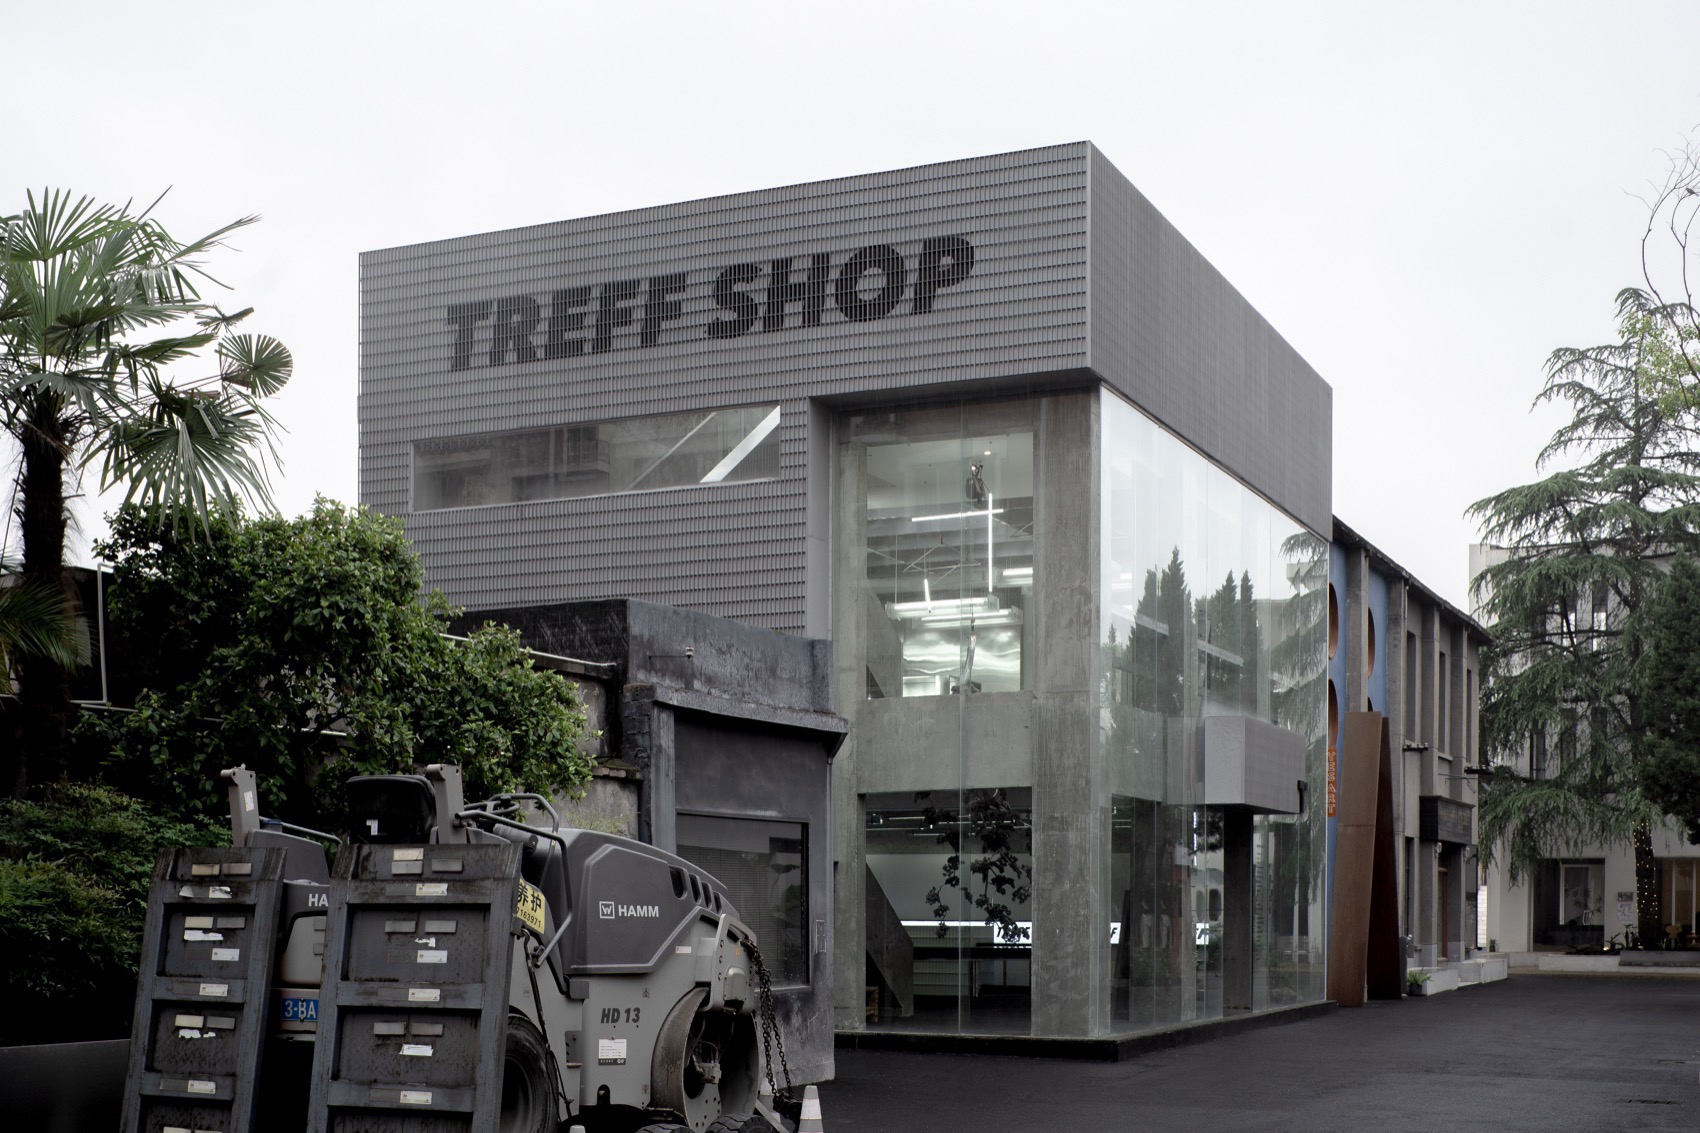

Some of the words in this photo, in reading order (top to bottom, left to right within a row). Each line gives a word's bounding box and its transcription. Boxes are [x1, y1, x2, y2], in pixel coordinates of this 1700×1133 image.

[445, 272, 687, 373] TREFF
[704, 235, 976, 340] SHOP
[618, 904, 659, 918] HAMM
[600, 1007, 621, 1024] HD
[624, 1007, 641, 1024] 13
